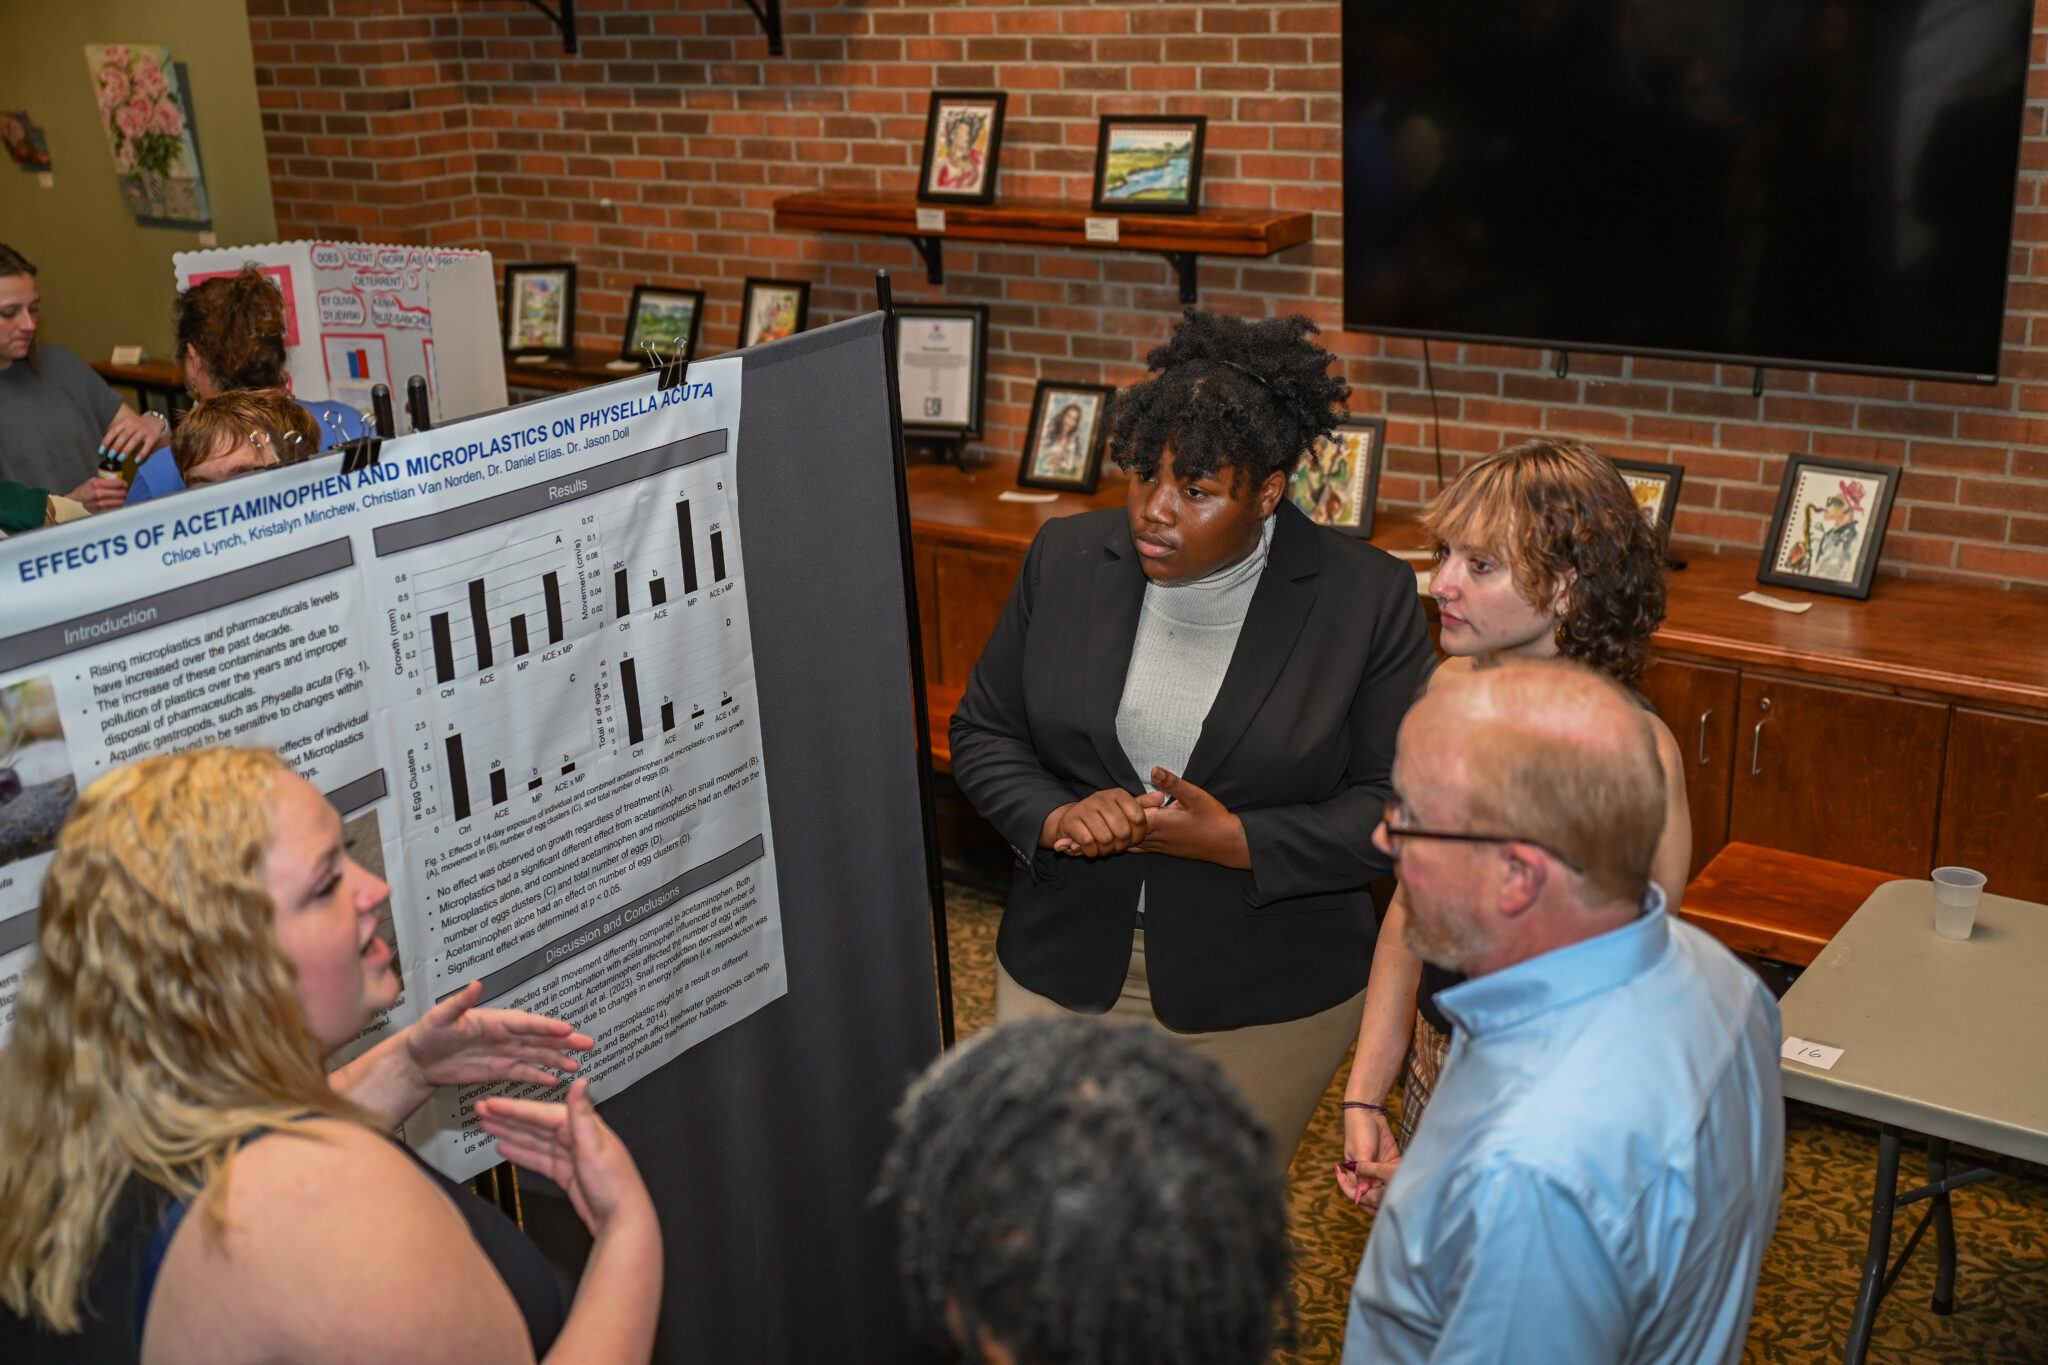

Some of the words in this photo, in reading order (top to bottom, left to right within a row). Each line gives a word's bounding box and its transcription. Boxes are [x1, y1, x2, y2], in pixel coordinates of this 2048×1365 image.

[18, 534, 129, 583] EFFECTS
[134, 524, 165, 550] OF
[172, 474, 352, 541] ACETAMINOPHEN
[357, 462, 400, 489] AND
[406, 425, 548, 477] MICROPLASTICS
[552, 417, 575, 438] ON
[580, 395, 658, 432] PHYSELLA
[661, 382, 714, 409] ACUTA
[161, 545, 200, 567] Chloe
[203, 533, 247, 556] Lynch,
[249, 518, 302, 542] Kristalyn
[304, 502, 360, 526] Minchew,
[362, 486, 416, 508] Christian
[417, 478, 442, 495] Van
[444, 469, 486, 489] Norden,
[487, 464, 503, 478] Dr.
[505, 453, 537, 472] Daniel
[567, 442, 582, 455] Dr.
[583, 434, 611, 450] Jason
[612, 426, 630, 441] Doll
[548, 478, 588, 501] Results
[398, 593, 409, 603] 0.5
[577, 572, 589, 621] Movement
[687, 597, 698, 608] MP
[63, 606, 158, 646] Introduction
[400, 612, 412, 622] 0.4
[619, 621, 631, 632] Ctrl
[653, 609, 668, 621] ACE
[89, 659, 127, 679] Rising
[129, 635, 201, 667] microplastics
[204, 626, 224, 643] and
[226, 601, 309, 637] pharmaceuticals
[310, 590, 340, 607] levels
[403, 631, 414, 641] 0.3
[93, 679, 122, 696] have
[125, 659, 180, 686] increased
[182, 651, 206, 667] over
[208, 645, 225, 658] the
[227, 636, 251, 654] past
[253, 623, 293, 644] decade.
[96, 696, 120, 713] The
[121, 681, 170, 704] increase
[172, 674, 184, 688] of
[186, 666, 216, 682] these
[218, 641, 287, 673] contaminants
[289, 635, 306, 649] are
[307, 628, 327, 642] due
[329, 623, 339, 635] to
[390, 635, 404, 676] Growth
[405, 650, 417, 660] 0.2
[517, 660, 530, 672] MP
[100, 705, 148, 733] pollution
[151, 698, 163, 713] of
[165, 686, 206, 711] plastics
[208, 677, 232, 693] over
[234, 670, 250, 684] the
[253, 660, 281, 680] years
[283, 651, 303, 667] and
[305, 636, 348, 659] improper
[408, 669, 419, 679] 0.1
[479, 673, 496, 687] ACE
[440, 687, 456, 699] Ctrl
[104, 721, 151, 747] disposal
[153, 715, 165, 729] of
[167, 686, 256, 727] pharmaceuticals.
[109, 740, 152, 764] Aquatic
[218, 705, 243, 723] such
[246, 701, 259, 714] as
[260, 683, 303, 708] Physella
[305, 674, 333, 692] acuta
[204, 734, 216, 745] to
[217, 728, 231, 741] be
[234, 710, 278, 734] sensitive
[280, 706, 291, 718] to
[292, 690, 335, 713] changes
[336, 678, 364, 697] within
[414, 721, 426, 732] 2.5
[278, 733, 312, 754] effects
[314, 728, 325, 742] of
[325, 710, 369, 738] individual
[303, 730, 365, 762] Microplastics
[664, 734, 677, 746] ACE
[407, 748, 419, 790] Clusters
[411, 791, 422, 813] Egg
[494, 807, 511, 820] ACE
[437, 887, 451, 899] No
[453, 874, 478, 892] effect
[479, 867, 496, 880] was
[497, 847, 535, 872] observed
[536, 843, 547, 854] on
[548, 830, 574, 849] growth
[574, 810, 614, 835] regardless
[624, 790, 661, 813] treatment
[439, 882, 496, 914] Microplastics
[496, 873, 512, 886] had
[520, 850, 561, 876] significant
[561, 836, 593, 857] different
[594, 826, 615, 842] effect
[615, 817, 633, 831] from
[634, 792, 688, 822] acetaminophen
[698, 777, 715, 793] snail
[716, 763, 748, 784] movement
[458, 824, 473, 836] Ctrl
[445, 923, 513, 961] Acetaminophen
[513, 911, 536, 929] alone
[536, 903, 552, 916] had
[553, 898, 564, 908] an
[564, 885, 588, 903] effect
[587, 880, 598, 891] on
[599, 866, 627, 886] number
[637, 854, 652, 868] egg
[653, 841, 679, 860] clusters
[546, 927, 601, 964] Discussion
[603, 919, 623, 935] and
[624, 886, 680, 923] Conclusions
[613, 1003, 656, 1033] microplastic
[656, 992, 675, 1010] might
[690, 971, 711, 988] result
[721, 950, 749, 971] different
[649, 1020, 670, 1038] affect
[670, 999, 704, 1024] freshwater
[705, 979, 743, 1006] gastropods
[743, 970, 755, 983] can
[603, 1037, 618, 1051] and
[1798, 1047, 1822, 1058] 16
